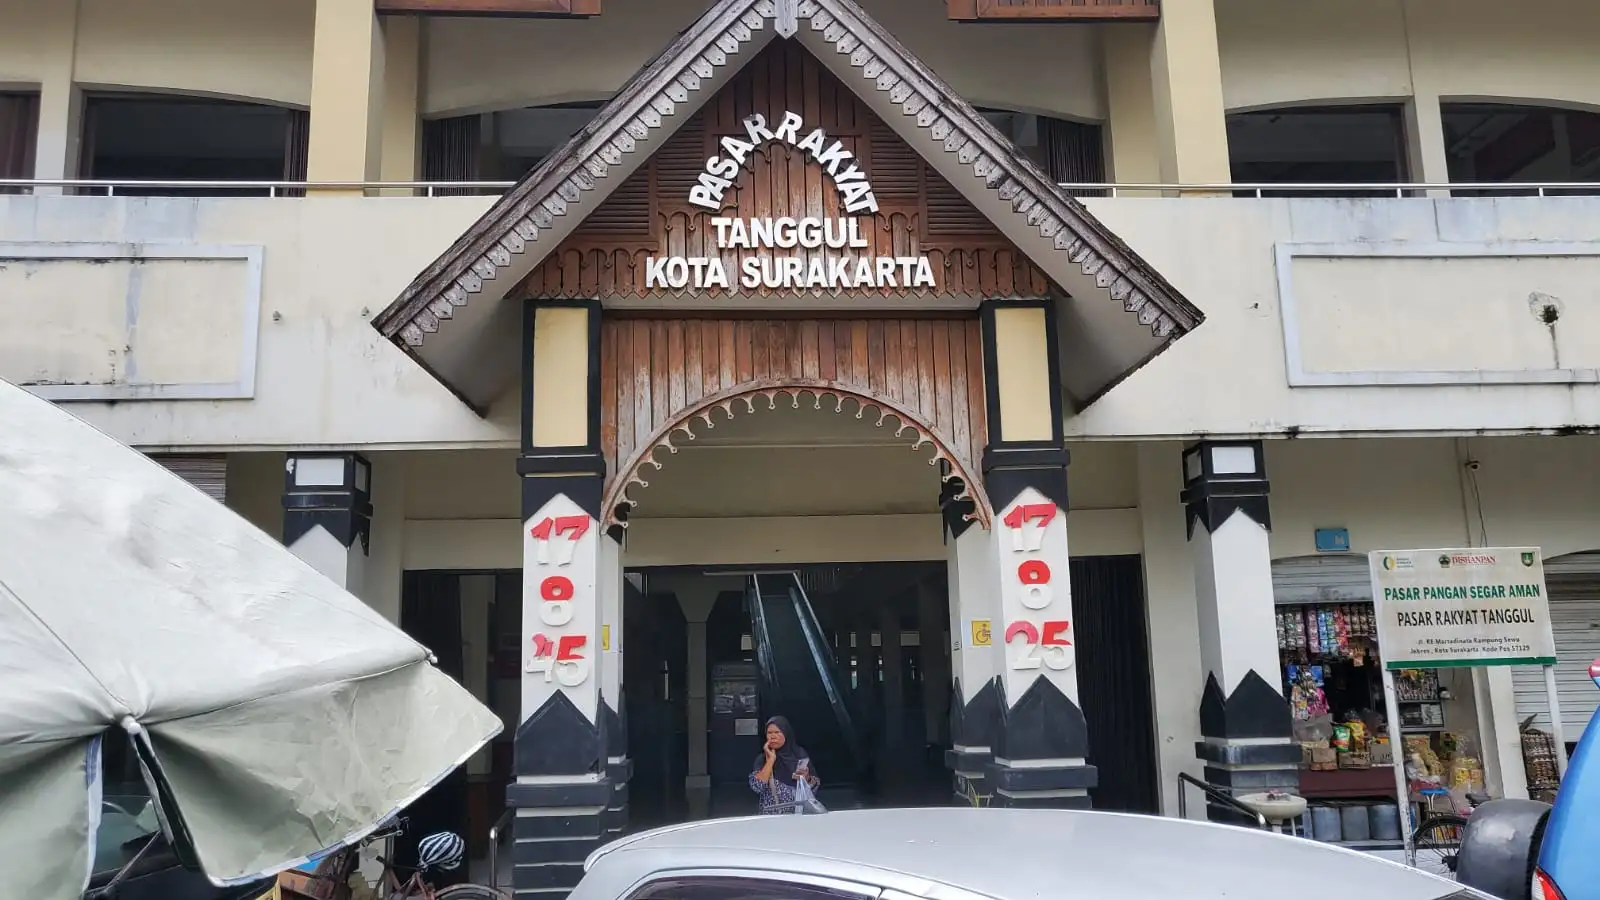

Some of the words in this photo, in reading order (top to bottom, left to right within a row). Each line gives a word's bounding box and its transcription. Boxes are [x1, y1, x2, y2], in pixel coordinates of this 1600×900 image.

[688, 113, 776, 211] PASAR
[774, 110, 879, 214] RAKYAT
[711, 216, 868, 249] TANGGUL
[645, 256, 729, 288] KOTA
[741, 255, 936, 288] SURAKARTA
[530, 514, 590, 567] 17
[1003, 502, 1057, 552] 17
[540, 575, 574, 627] 8
[1018, 560, 1053, 610] 8
[1384, 587, 1420, 600] PASAR
[1423, 586, 1467, 600] PANGAN
[1470, 585, 1505, 599] SEGAR
[1508, 584, 1540, 597] AMAN
[1397, 611, 1433, 626] PASAR
[1435, 610, 1478, 625] RAKYAT
[1481, 608, 1535, 624] TANGGUL
[1005, 620, 1075, 671] 25
